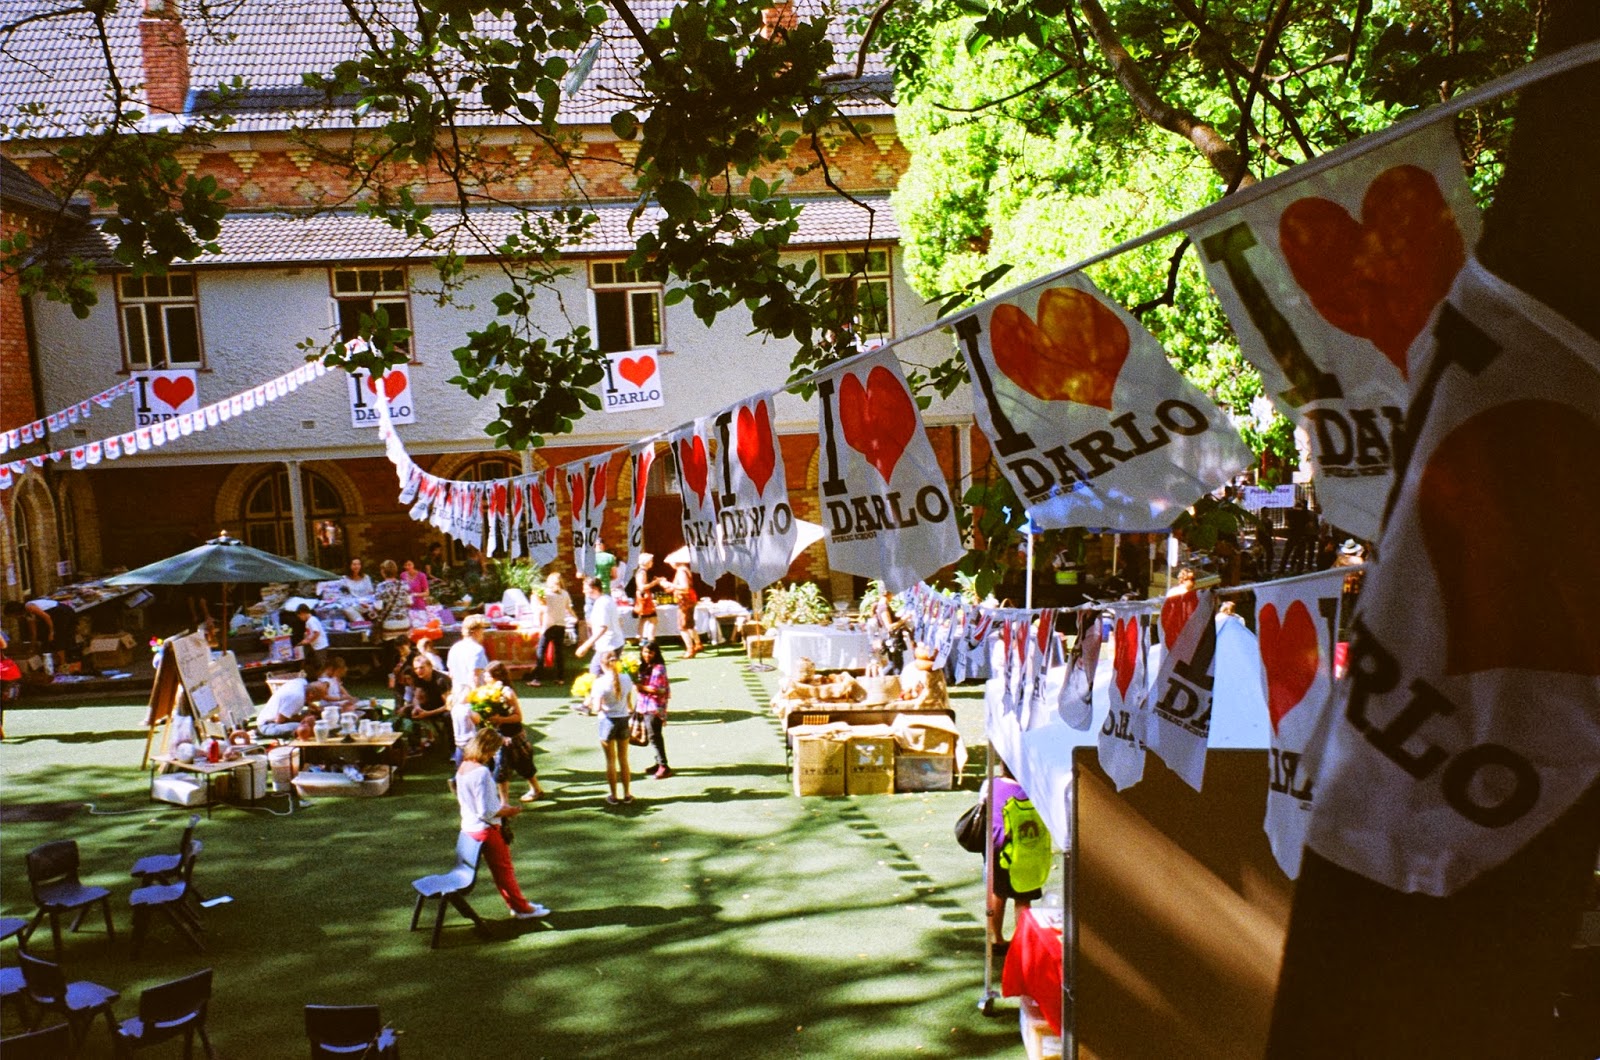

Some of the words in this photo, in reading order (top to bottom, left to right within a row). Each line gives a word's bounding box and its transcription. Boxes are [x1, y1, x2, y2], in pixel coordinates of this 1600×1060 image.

[1201, 221, 1344, 407] I
[136, 376, 151, 412] I
[351, 373, 367, 408] I
[601, 359, 618, 393] I
[607, 389, 660, 406] DARLO
[954, 314, 1036, 457] I
[354, 405, 411, 420] DALO
[716, 411, 736, 507] I
[818, 379, 848, 497] I
[1006, 399, 1209, 498] DARLO
[719, 502, 792, 541] DAO
[826, 485, 949, 536] DARLO
